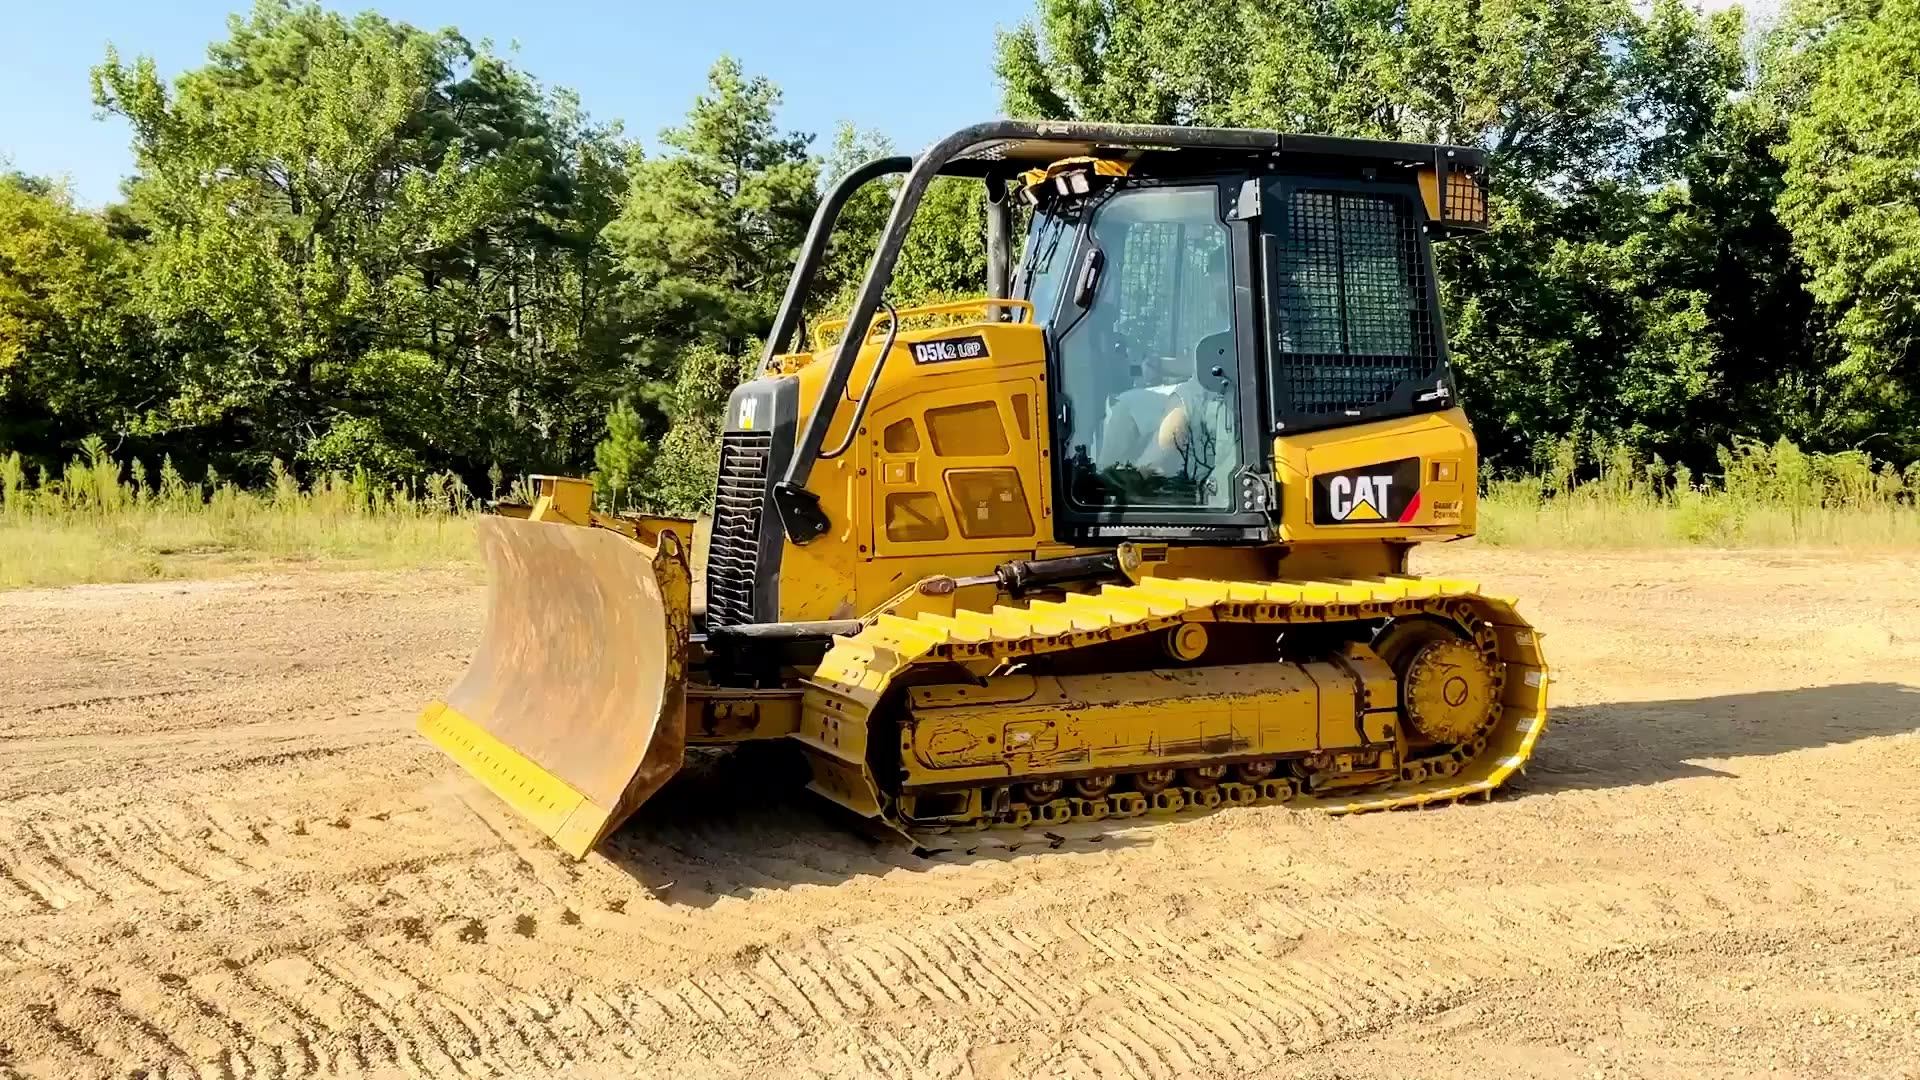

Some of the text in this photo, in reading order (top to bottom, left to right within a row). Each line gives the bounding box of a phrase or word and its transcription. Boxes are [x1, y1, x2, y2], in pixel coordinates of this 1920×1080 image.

[916, 342, 980, 362] D5K2 LGP
[739, 398, 757, 429] CAT
[1330, 475, 1392, 521] CAT
